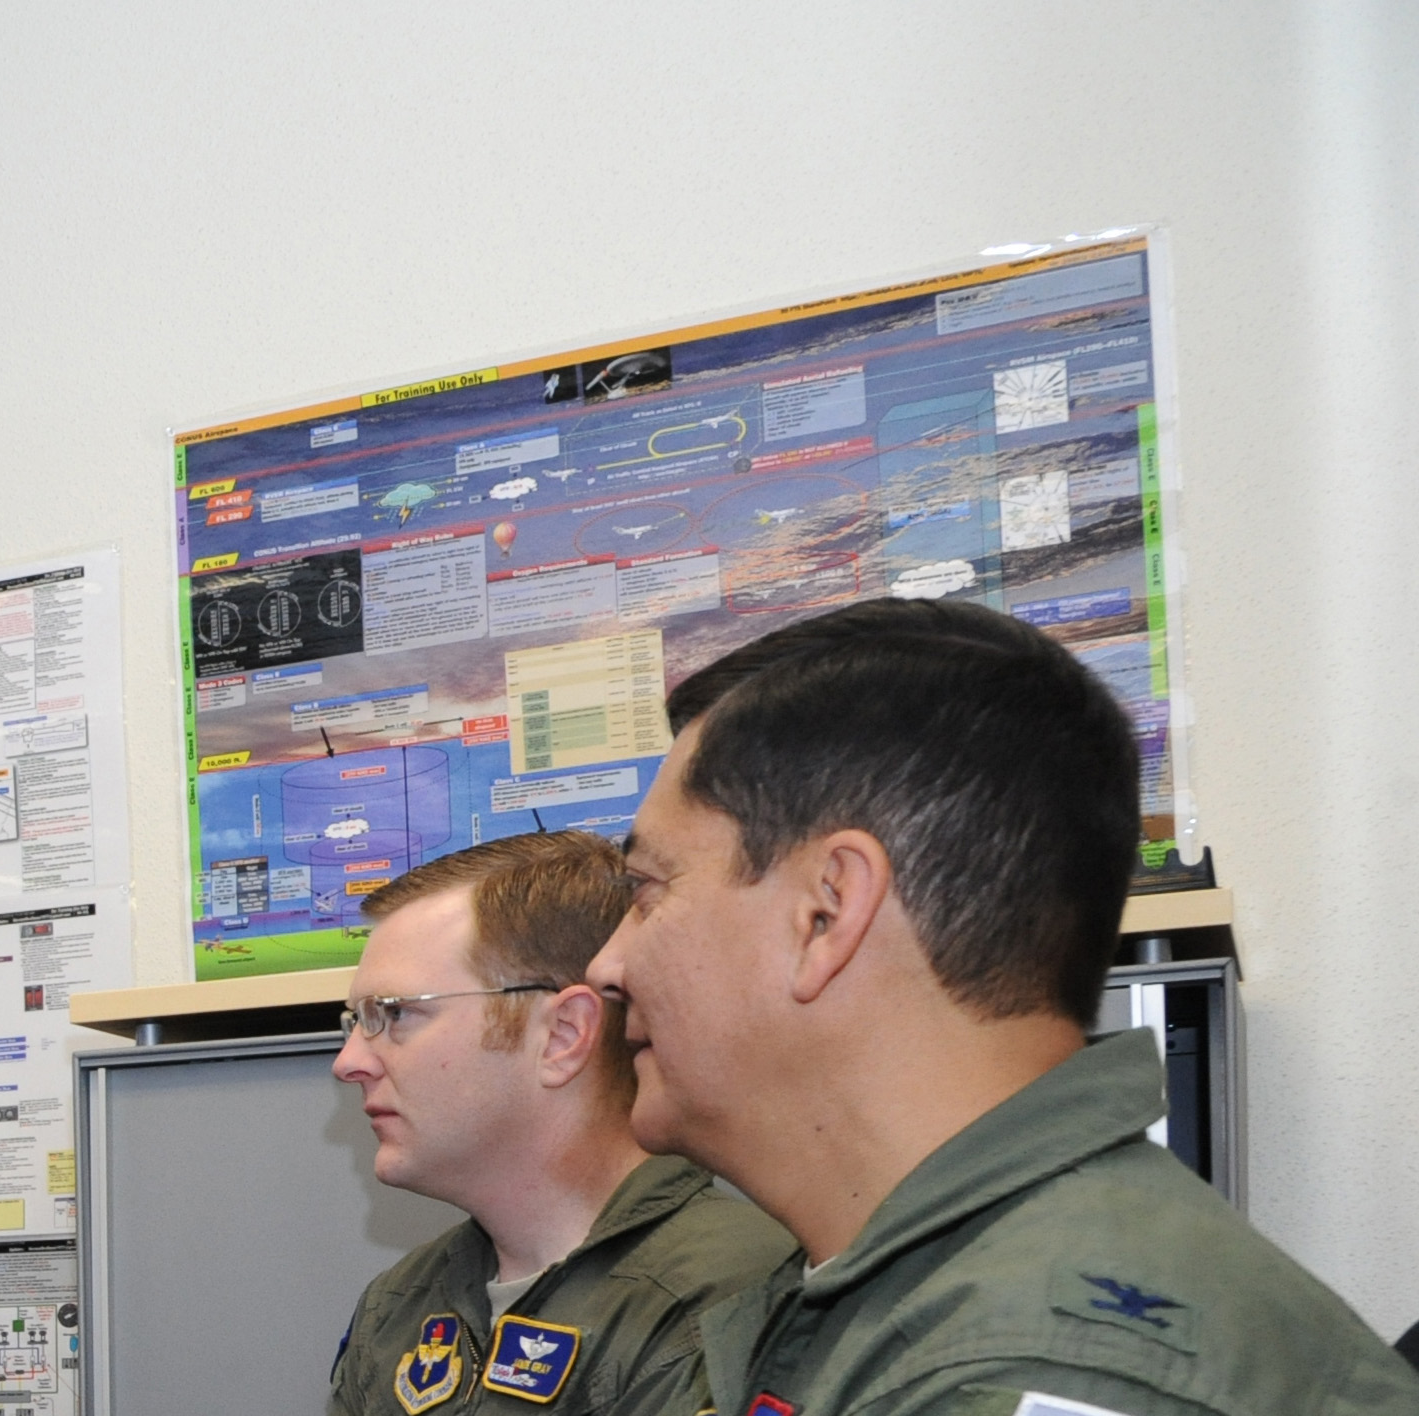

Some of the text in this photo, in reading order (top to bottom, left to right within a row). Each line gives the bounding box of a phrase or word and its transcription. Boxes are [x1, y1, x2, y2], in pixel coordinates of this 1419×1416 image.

[375, 373, 484, 404] For Training Use Only
